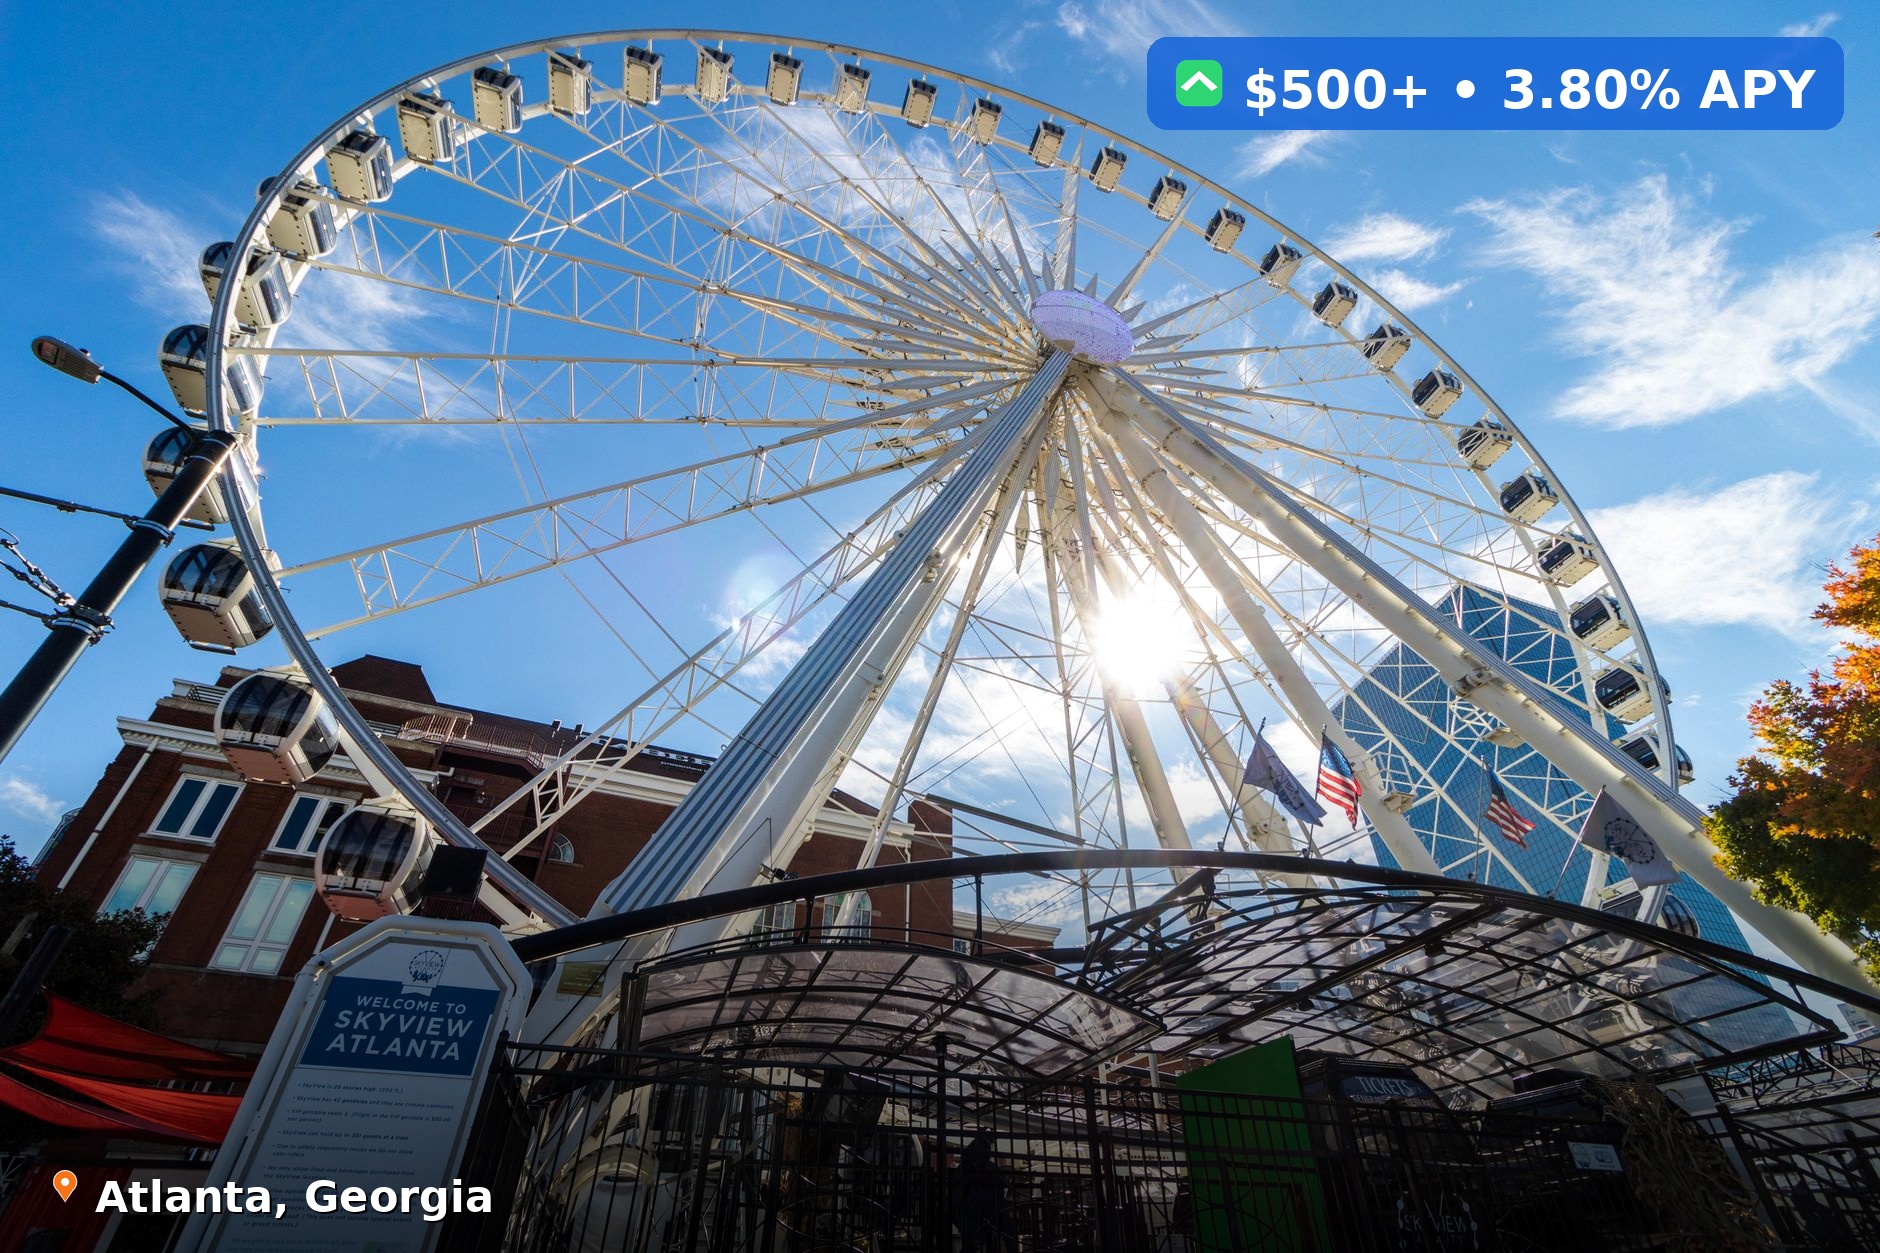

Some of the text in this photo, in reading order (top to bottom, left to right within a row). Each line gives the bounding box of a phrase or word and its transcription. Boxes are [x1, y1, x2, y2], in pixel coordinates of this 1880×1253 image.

[357, 995, 467, 1015] WELCOME TO
[334, 1009, 474, 1038] SKYVIEW
[325, 1032, 460, 1061] ATLANTA
[1354, 1075, 1415, 1097] TICKETS
